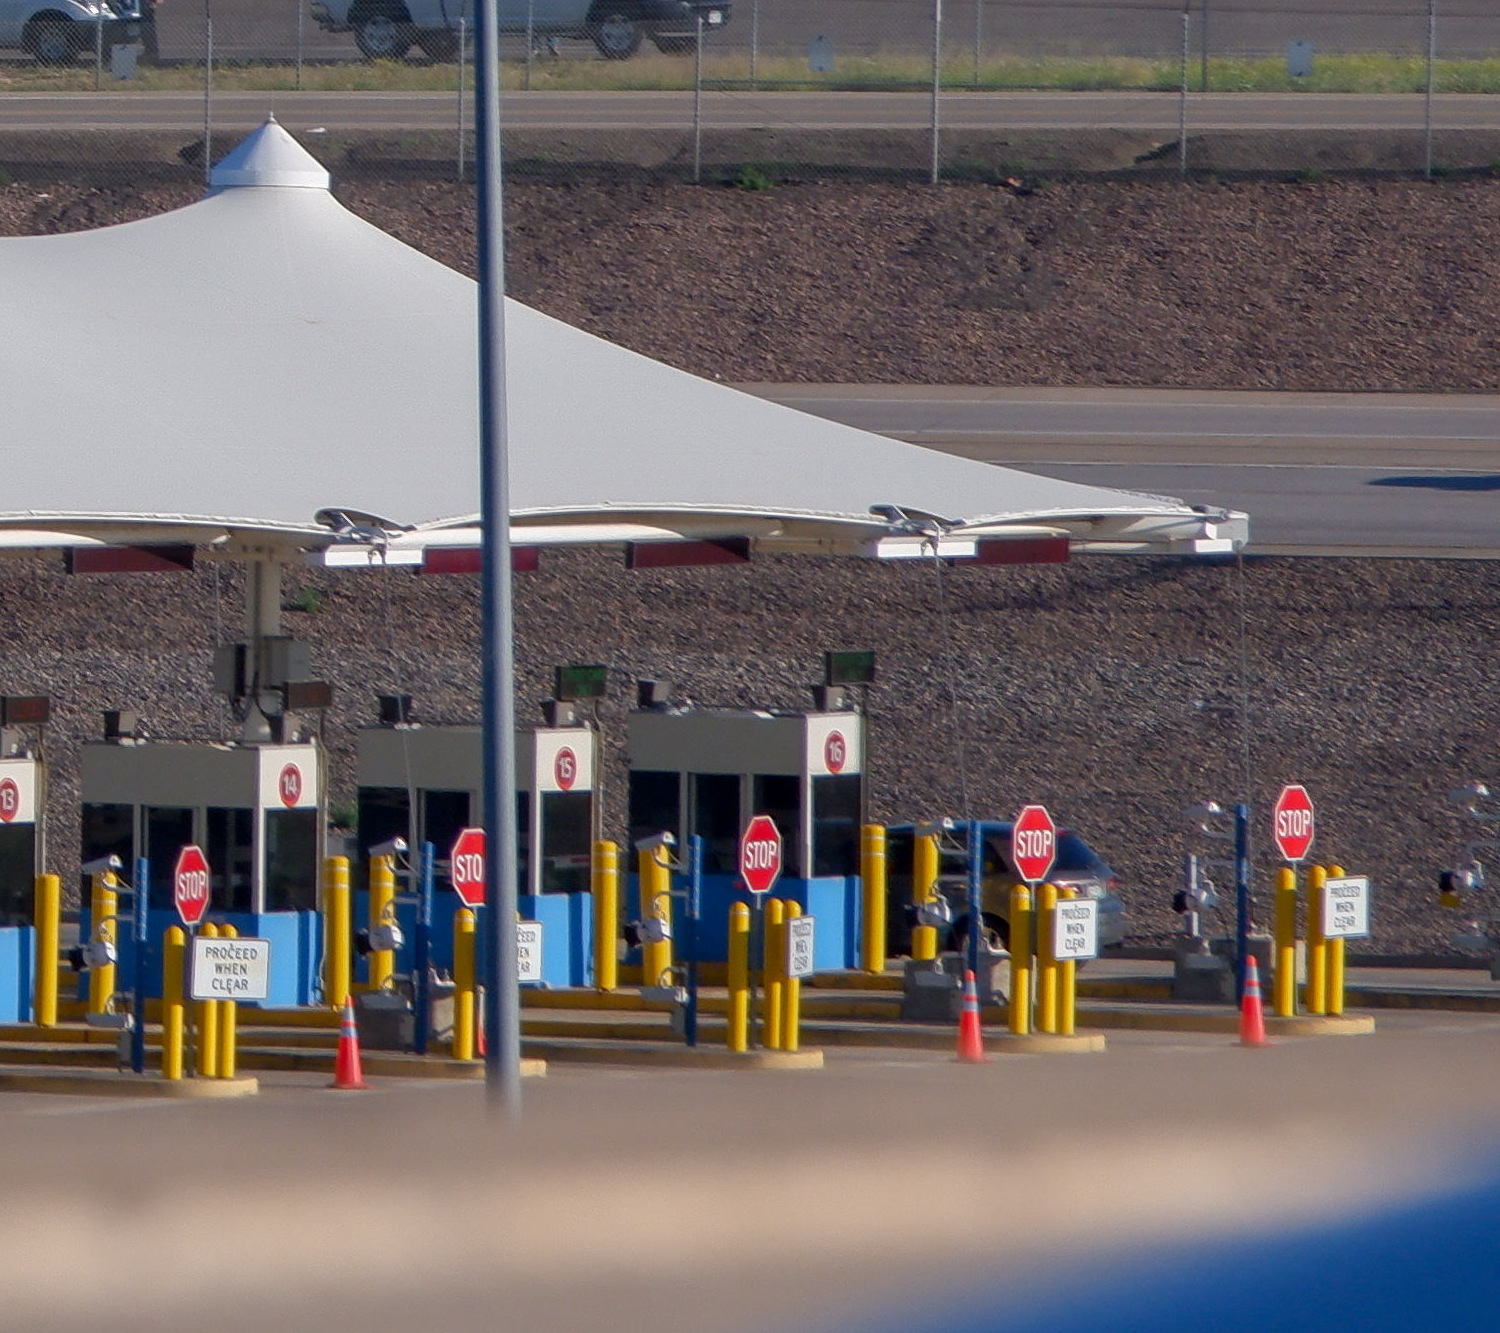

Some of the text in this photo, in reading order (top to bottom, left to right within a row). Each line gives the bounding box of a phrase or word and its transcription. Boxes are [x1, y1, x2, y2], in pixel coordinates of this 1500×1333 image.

[829, 741, 842, 763] 16
[558, 757, 573, 778] 15
[283, 774, 298, 796] 14
[0, 788, 14, 811] 13
[1278, 809, 1311, 837] STOP
[745, 840, 777, 870] STOP
[1017, 829, 1052, 859] STOP
[456, 853, 483, 882] STO
[178, 869, 207, 903] STOP
[205, 945, 258, 960] PROCEED
[519, 946, 530, 958] EN
[214, 961, 248, 975] WHEN
[211, 977, 249, 991] CLEAR
